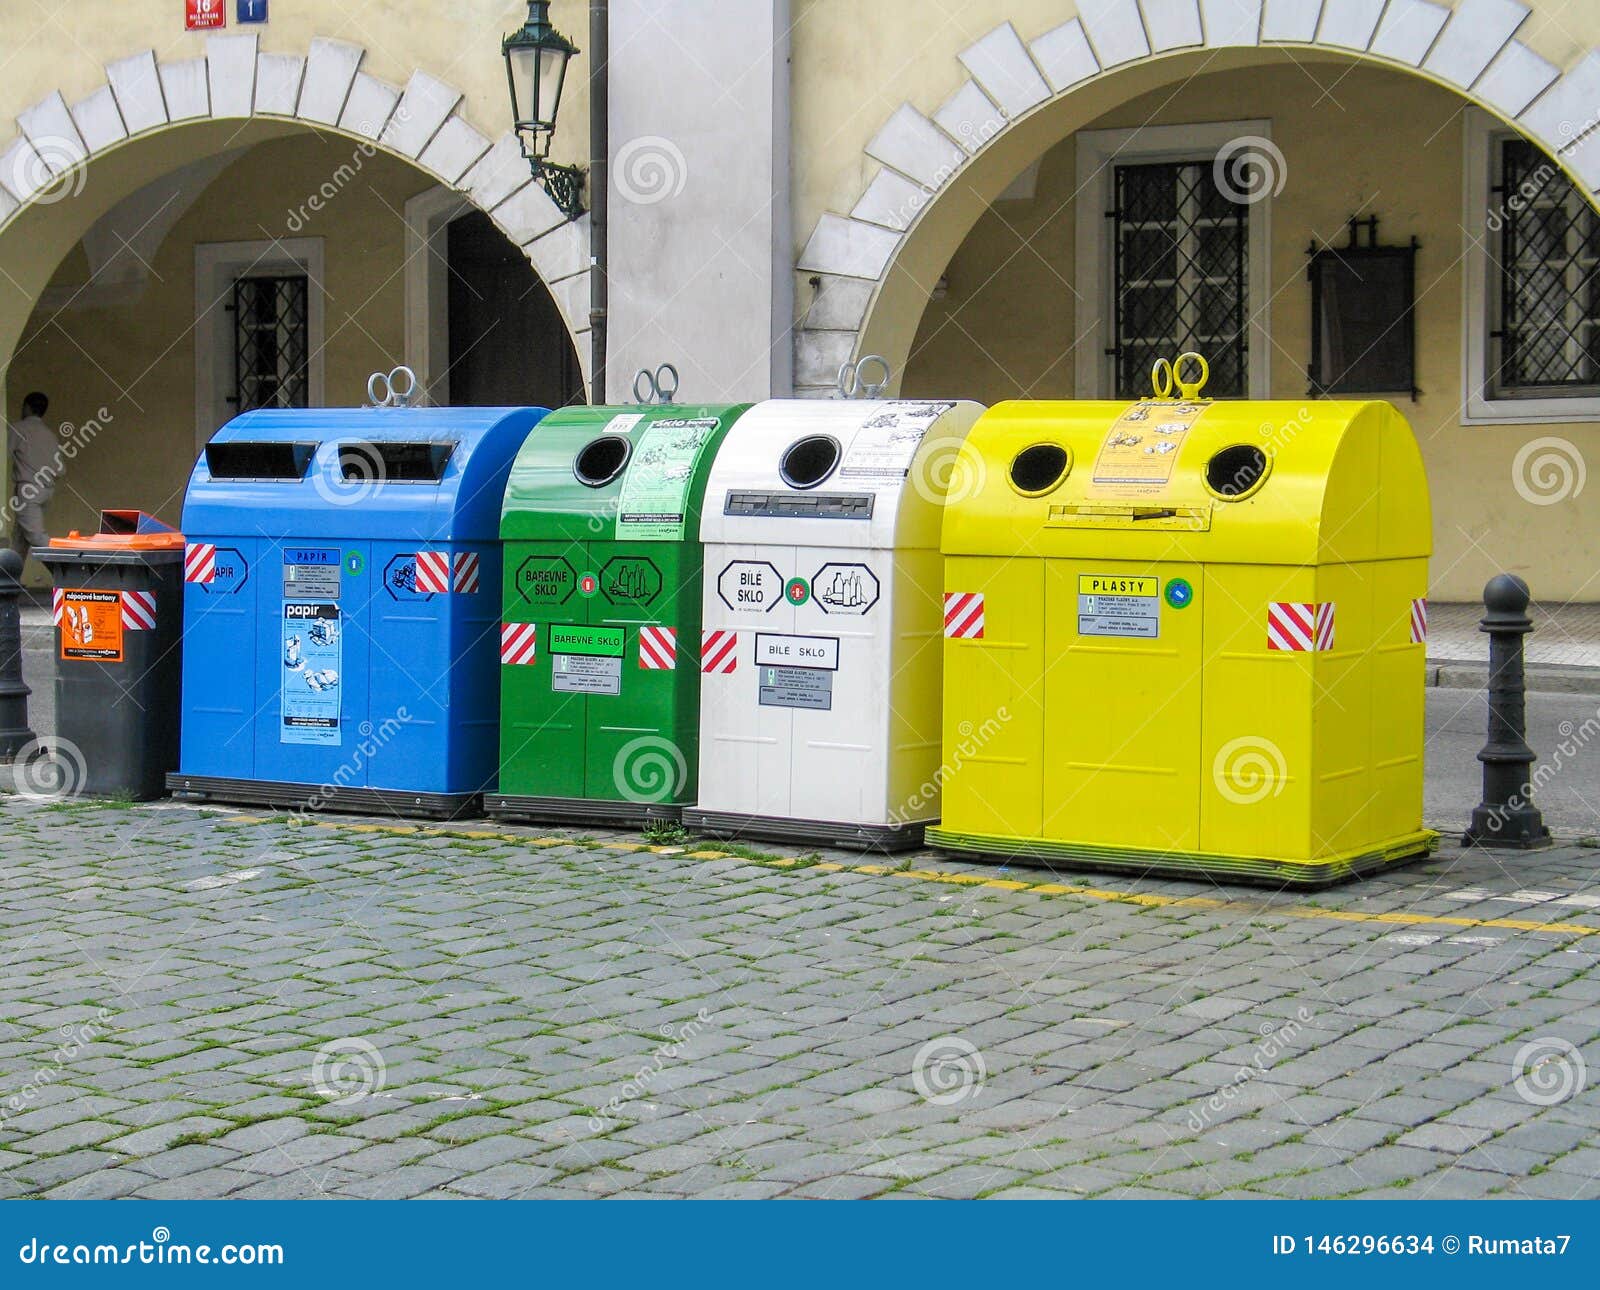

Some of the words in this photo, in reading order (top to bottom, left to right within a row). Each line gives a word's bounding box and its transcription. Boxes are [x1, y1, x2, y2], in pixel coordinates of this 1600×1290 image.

[213, 565, 234, 578] APÍR
[740, 569, 762, 586] BÍLÉ
[535, 584, 558, 596] SKLO
[1093, 580, 1144, 593] PLASTY
[738, 589, 764, 603] SKLO
[597, 637, 620, 647] SKLO
[799, 647, 826, 658] SKLO
